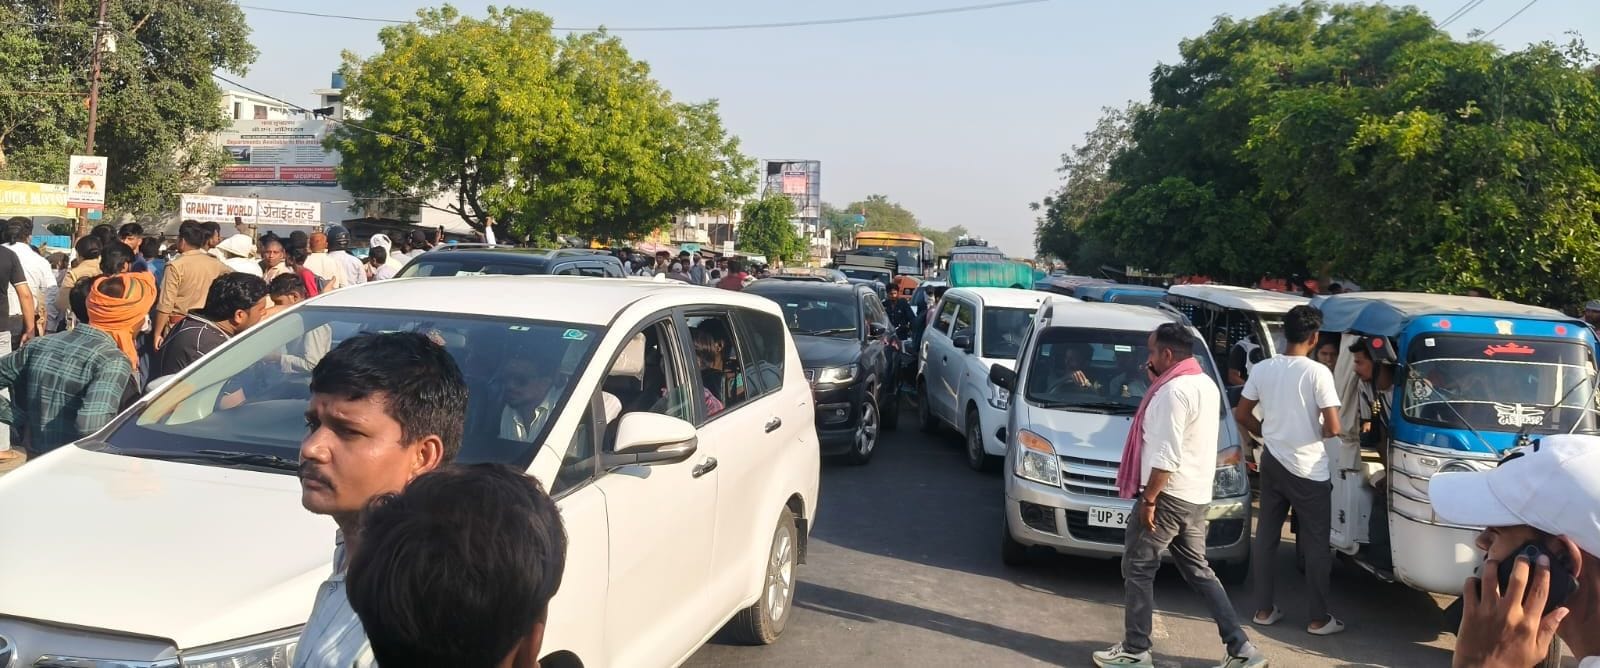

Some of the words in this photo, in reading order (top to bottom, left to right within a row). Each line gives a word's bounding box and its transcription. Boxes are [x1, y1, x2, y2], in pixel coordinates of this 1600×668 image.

[185, 201, 223, 215] GRANITE
[226, 204, 253, 217] WORLD
[1097, 510, 1113, 523] UP
